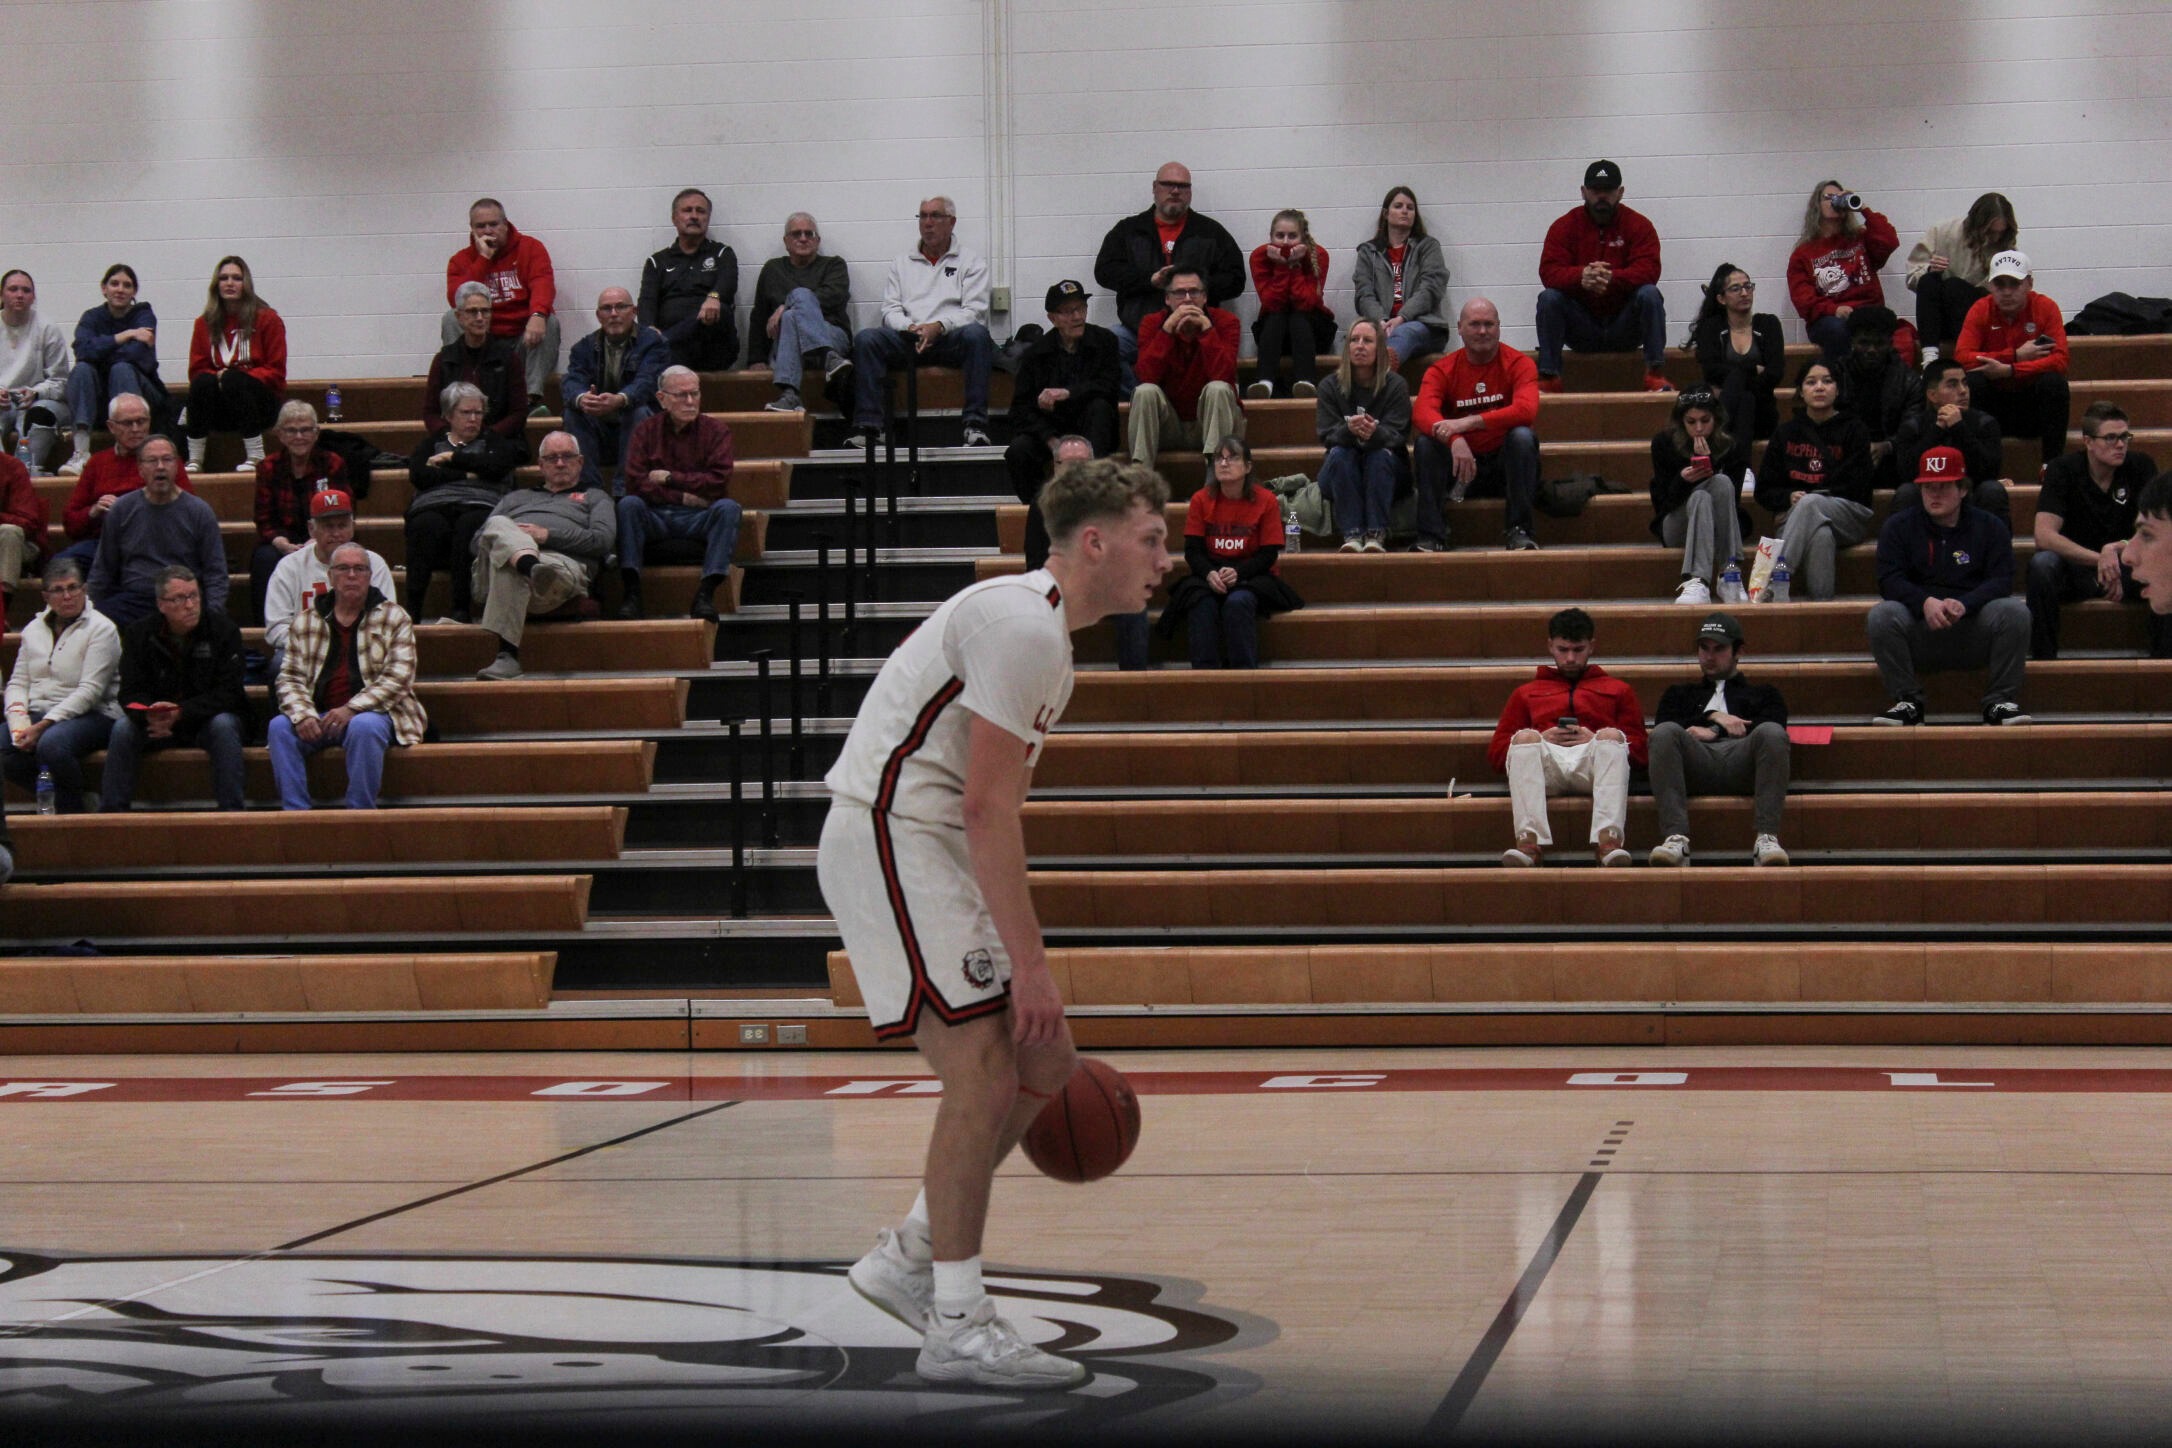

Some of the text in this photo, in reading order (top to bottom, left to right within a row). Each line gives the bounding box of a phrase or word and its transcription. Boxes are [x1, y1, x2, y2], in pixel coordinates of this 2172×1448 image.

[1925, 457, 1947, 473] KU
[324, 494, 340, 507] M
[1214, 538, 1244, 550] MOM
